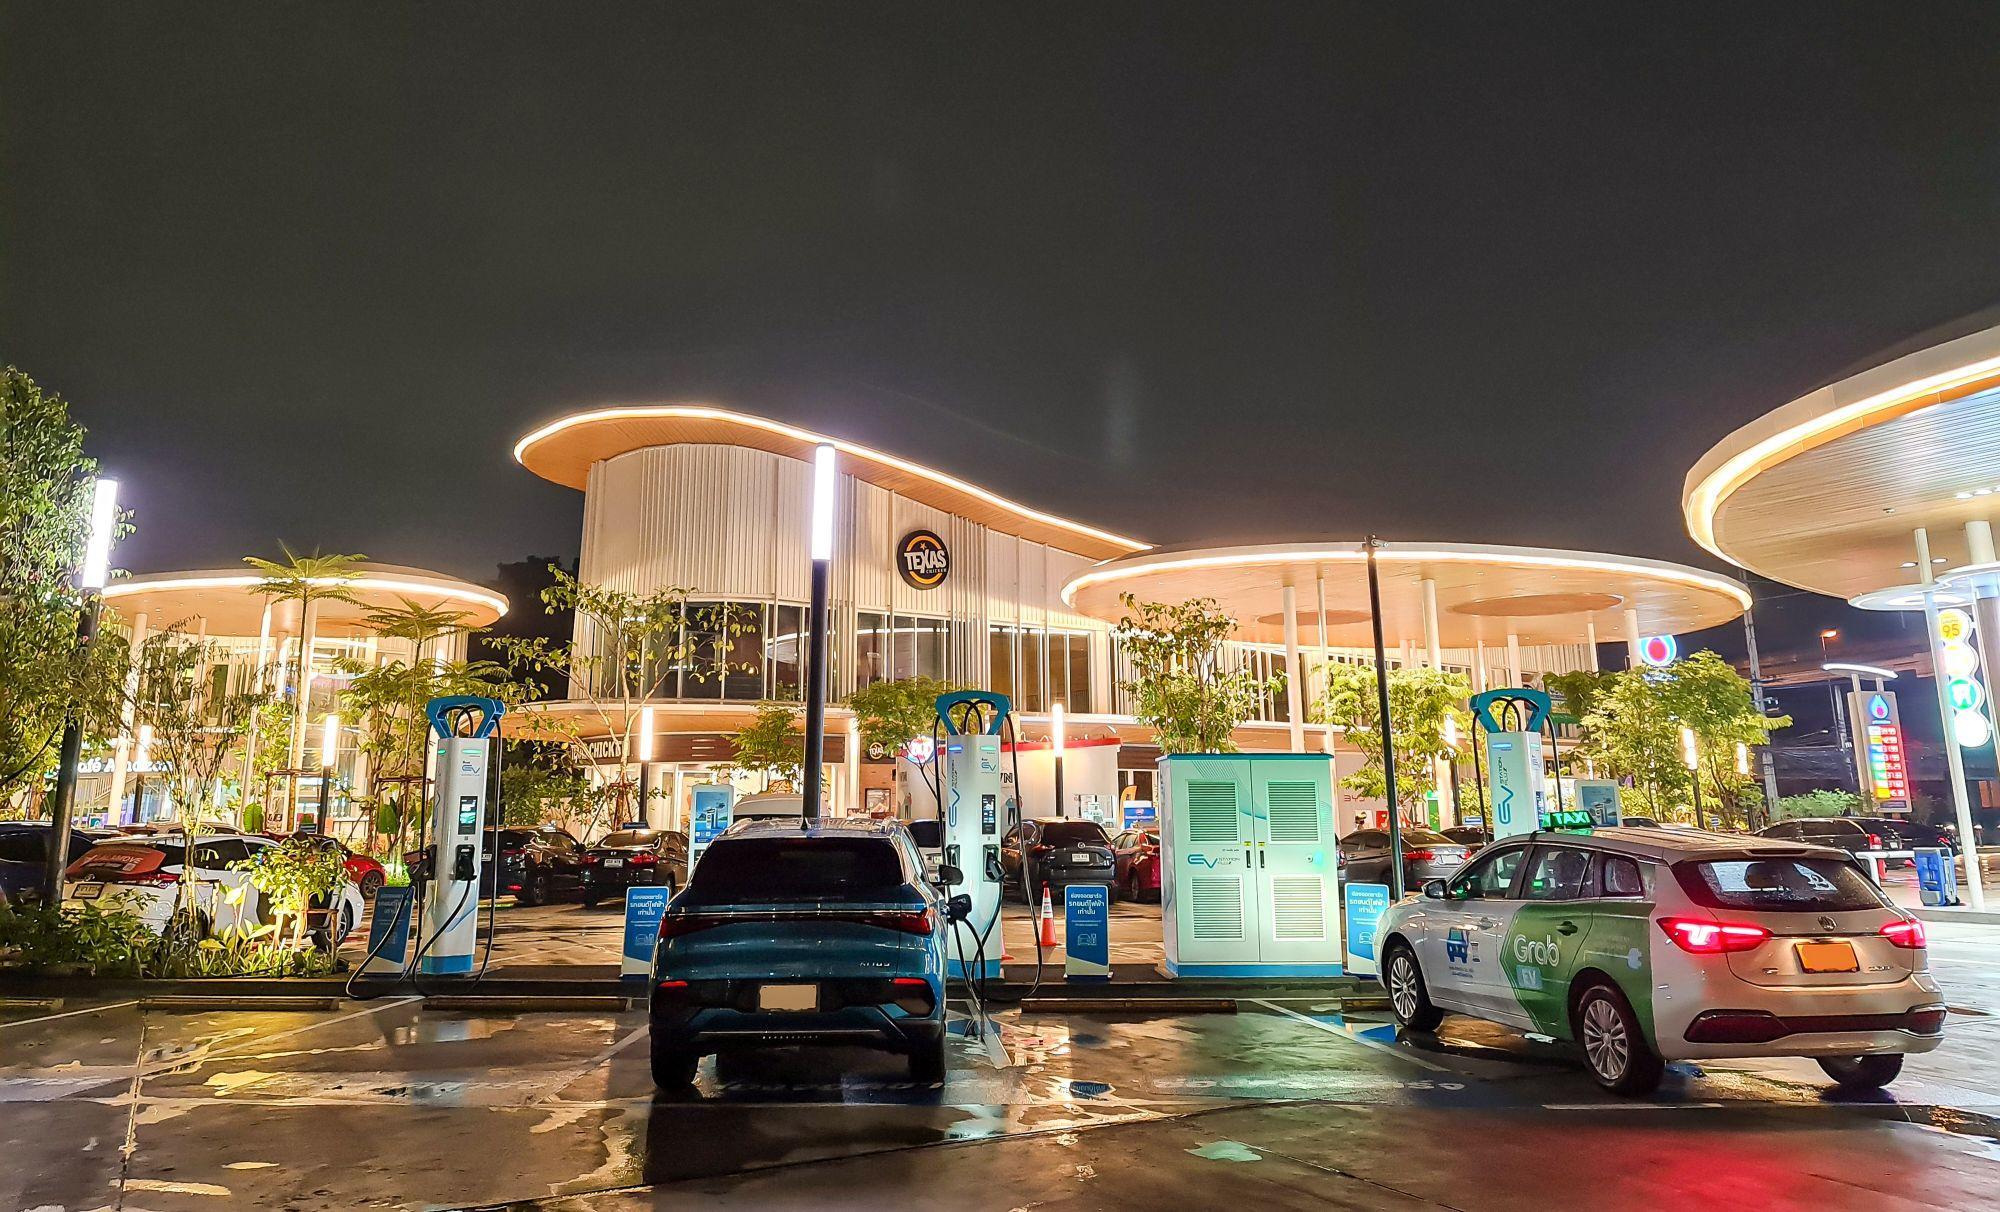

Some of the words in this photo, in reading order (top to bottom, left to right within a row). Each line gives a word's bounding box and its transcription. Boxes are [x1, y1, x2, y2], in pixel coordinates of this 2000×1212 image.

[904, 549, 947, 574] TEXAS
[1942, 624, 1961, 637] 95
[589, 740, 631, 759] CHICKE
[1552, 812, 1591, 825] TAXI
[1187, 854, 1218, 869] EV
[1513, 934, 1560, 967] Grab
